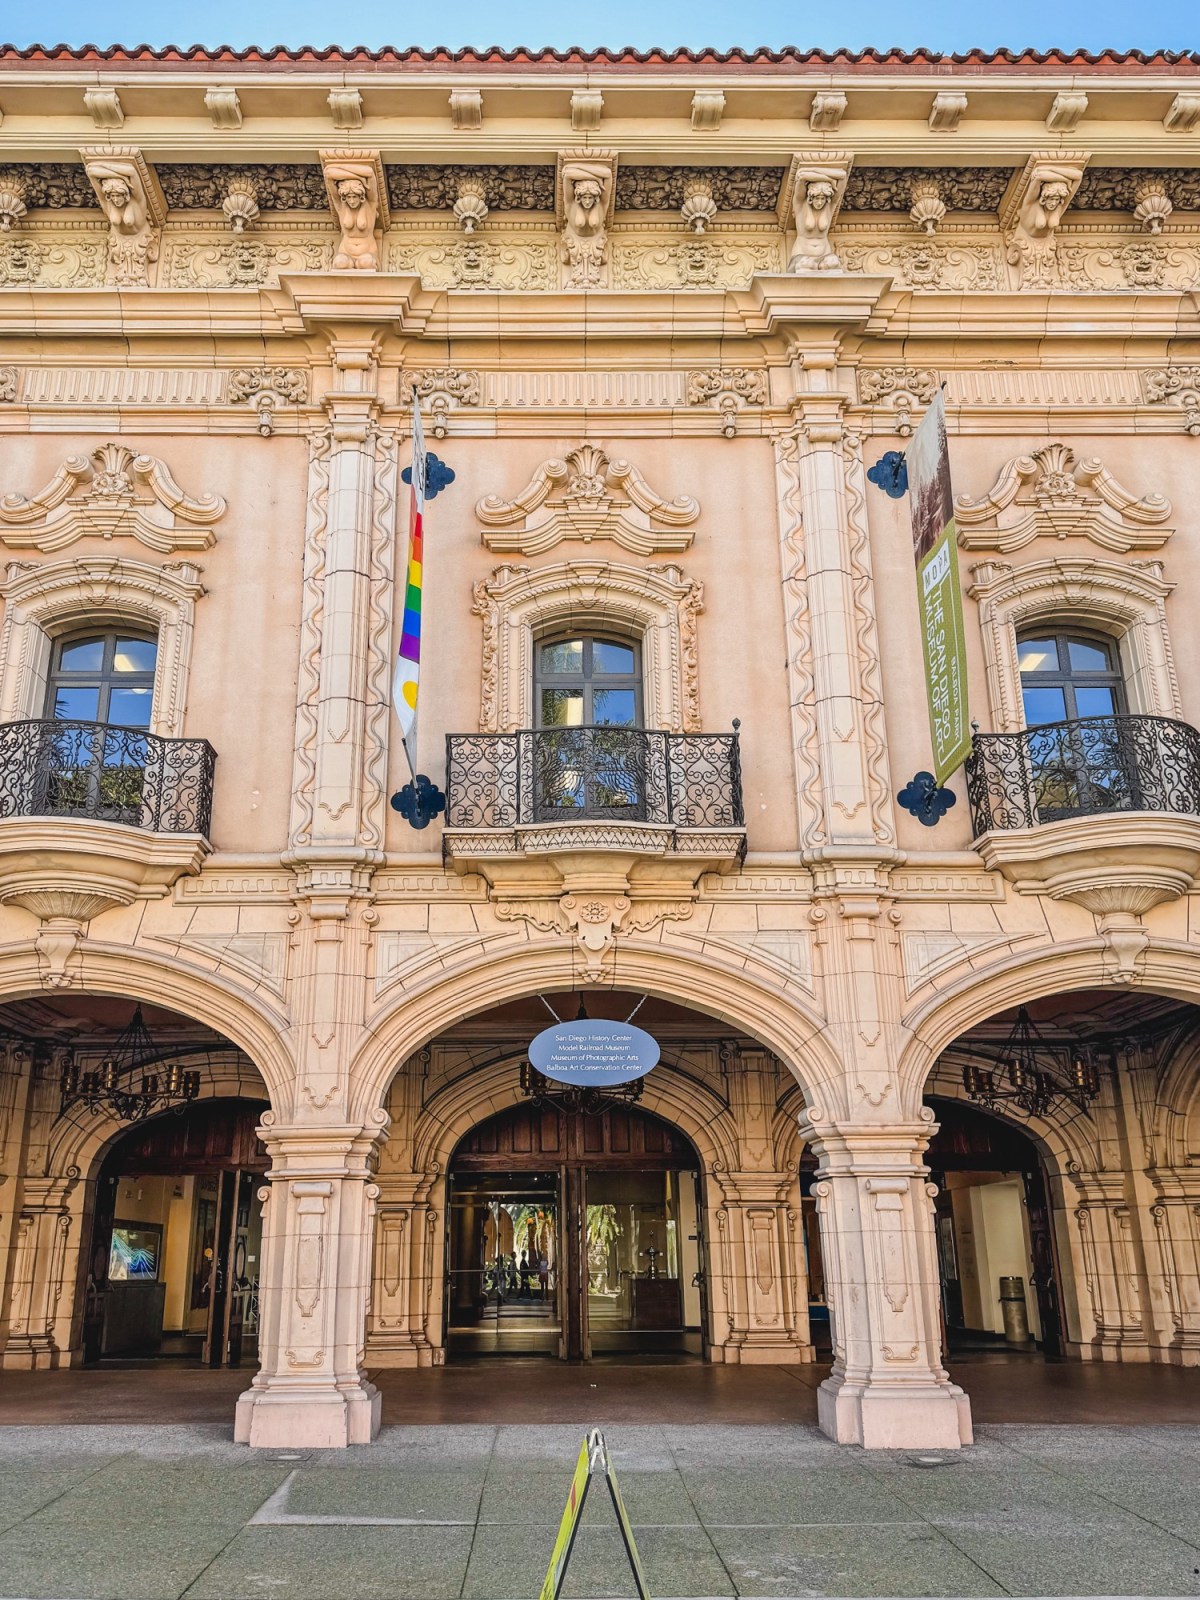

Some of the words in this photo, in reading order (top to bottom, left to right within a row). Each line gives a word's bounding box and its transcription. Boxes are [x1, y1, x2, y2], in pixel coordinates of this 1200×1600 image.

[932, 583, 944, 630] THE
[925, 595, 938, 685] MUSEUM
[936, 629, 947, 674] SAN
[932, 687, 941, 712] OF
[951, 656, 959, 705] BALBOA
[939, 674, 951, 740] DIEGO
[933, 717, 944, 753] ART
[555, 1034, 567, 1042] San
[568, 1034, 587, 1042] Diego
[588, 1034, 610, 1043] History
[611, 1034, 632, 1042] Center
[578, 1053, 585, 1061] of
[586, 1053, 625, 1063] Photographic
